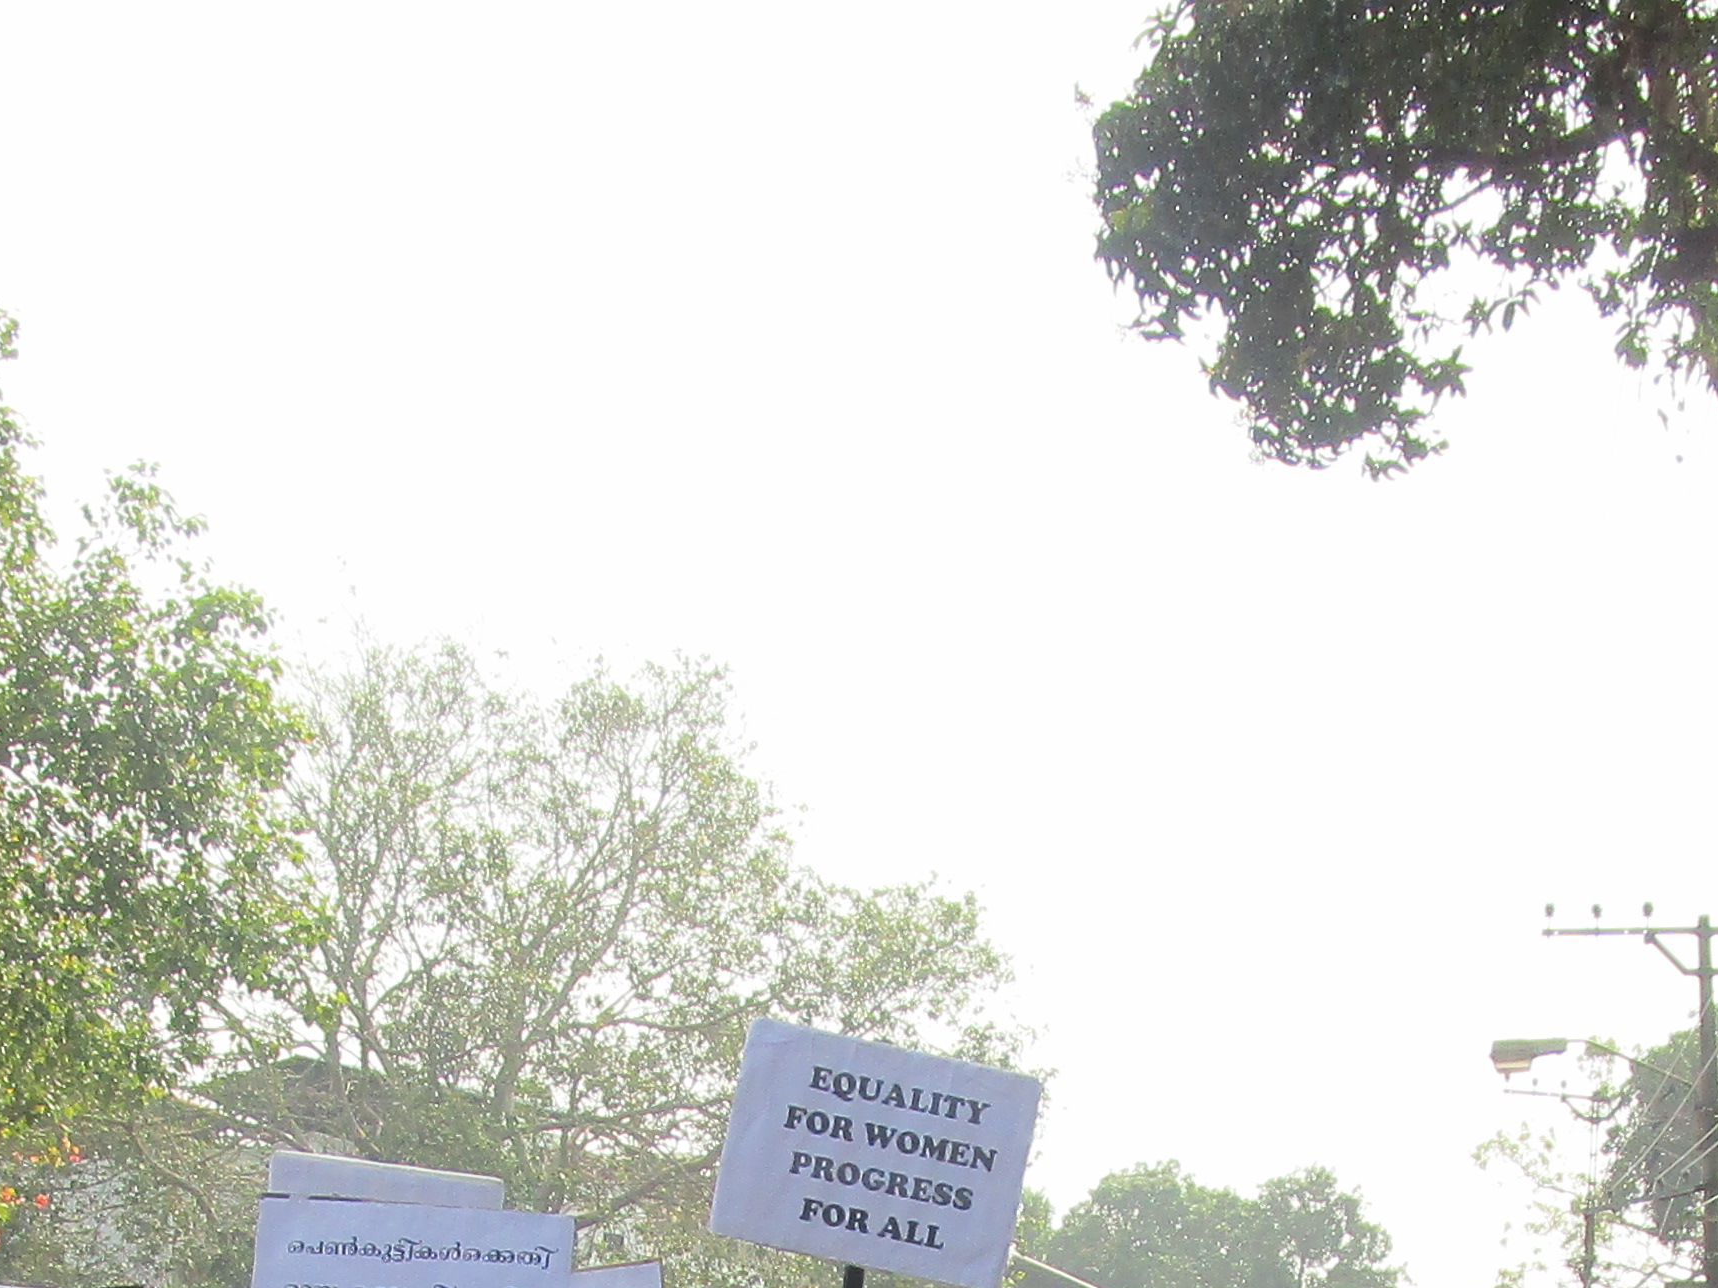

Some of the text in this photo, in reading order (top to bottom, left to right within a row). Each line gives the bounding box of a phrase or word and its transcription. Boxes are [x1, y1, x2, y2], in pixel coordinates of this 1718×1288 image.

[809, 1066, 991, 1124] EQUALITY
[783, 1104, 998, 1172] FOR WOMEN
[788, 1151, 974, 1210] PROGRESS
[799, 1198, 944, 1250] FOR ALL
